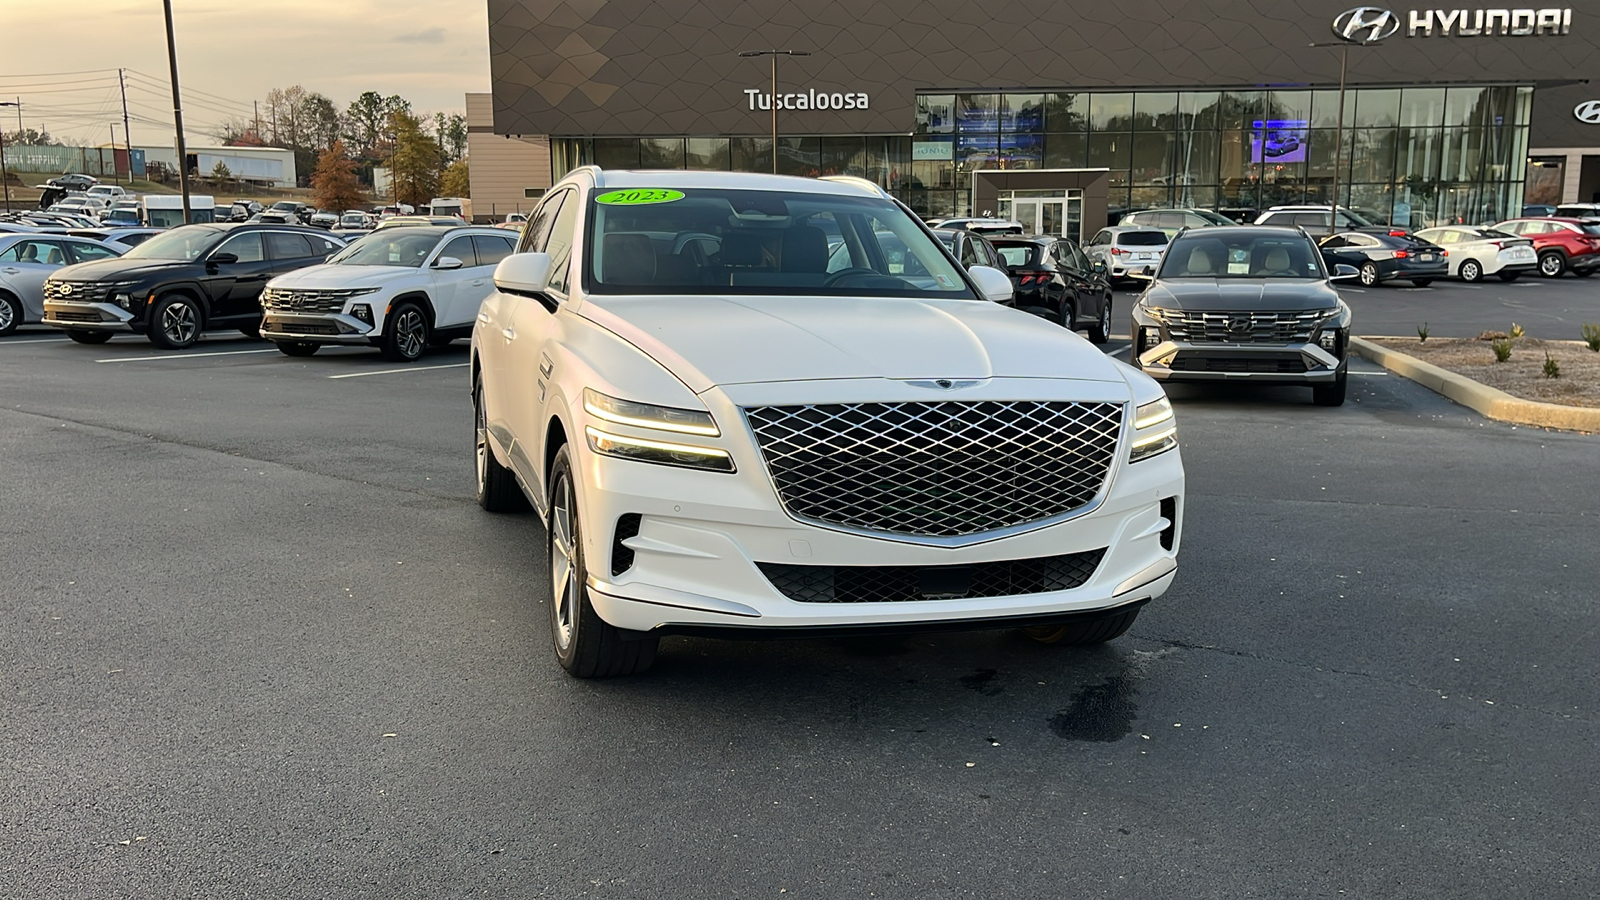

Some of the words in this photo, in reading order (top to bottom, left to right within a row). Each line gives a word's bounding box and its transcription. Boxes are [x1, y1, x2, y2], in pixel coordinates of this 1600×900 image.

[1408, 8, 1572, 36] HYUNDAI
[743, 88, 869, 110] Tuscaloosa
[27, 155, 60, 165] SHIPPING
[611, 190, 670, 203] 2023
